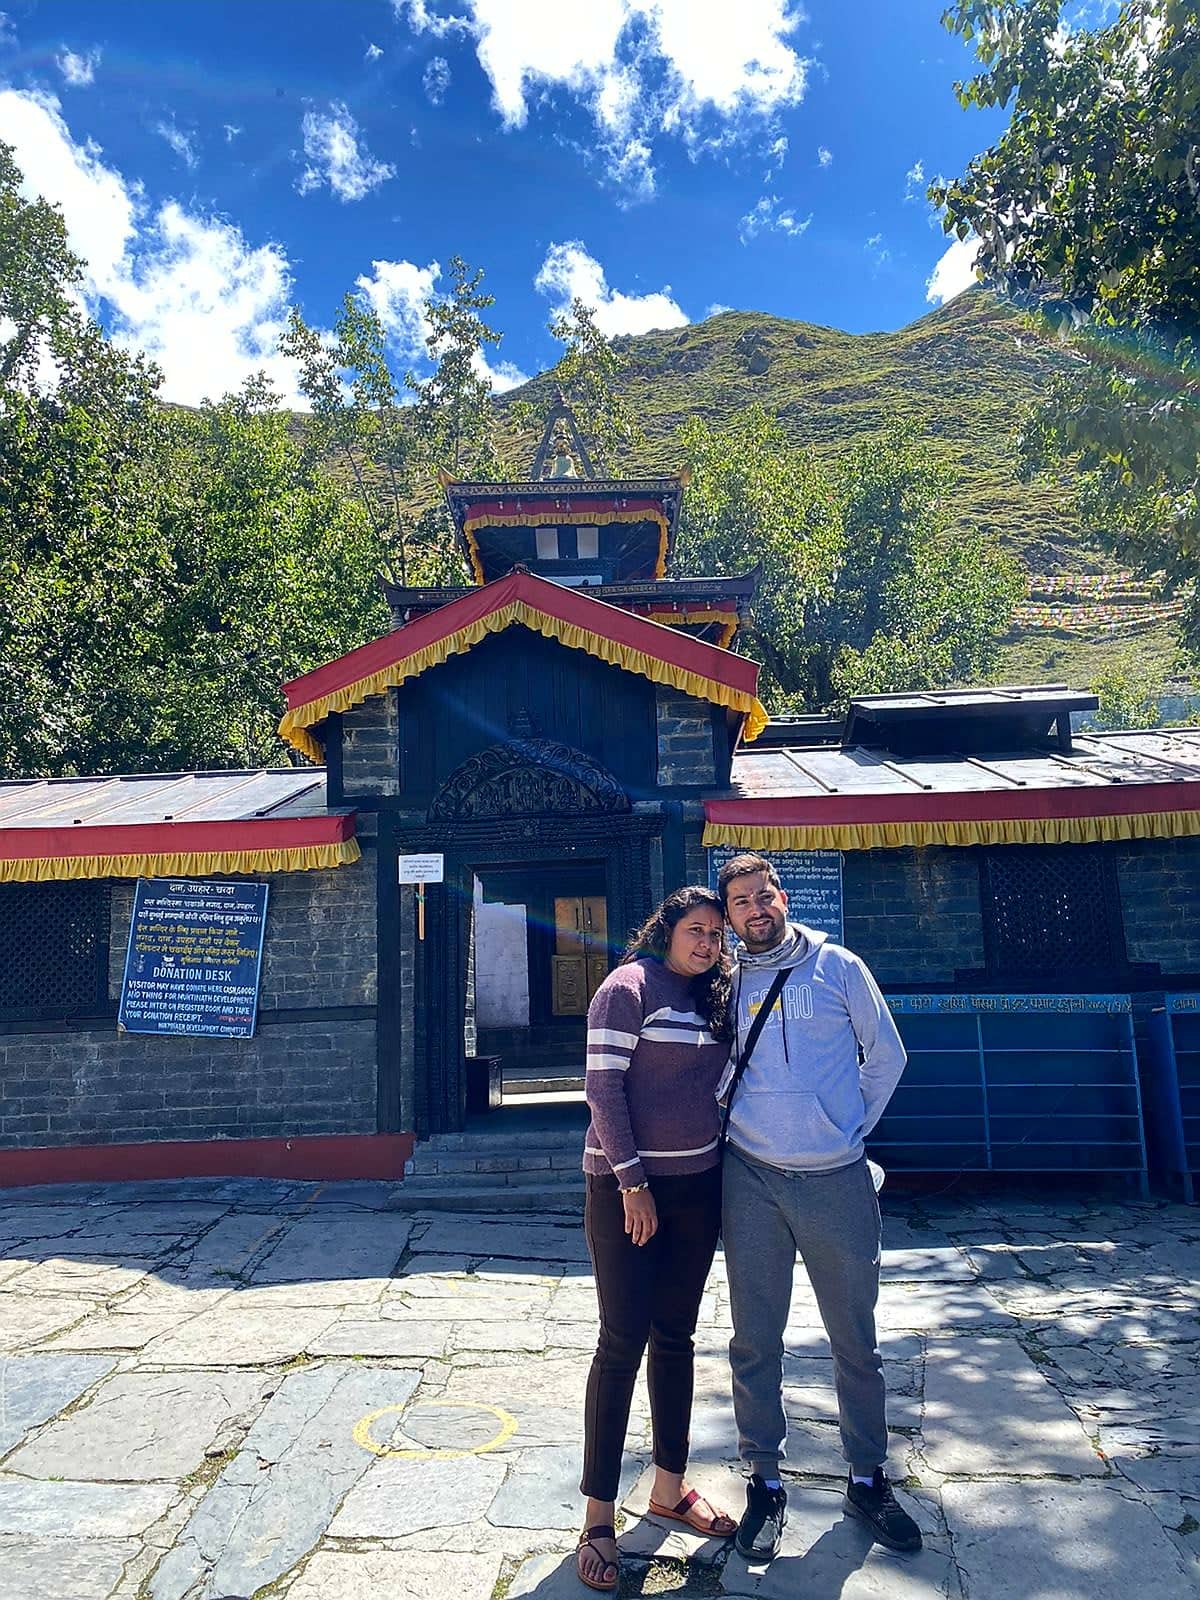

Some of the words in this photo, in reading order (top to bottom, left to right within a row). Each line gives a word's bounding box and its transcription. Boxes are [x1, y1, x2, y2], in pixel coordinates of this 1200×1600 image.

[153, 967, 202, 980] DONATION
[205, 969, 232, 982] DESK
[156, 982, 169, 991] MAY
[170, 983, 185, 991] HAVE
[186, 984, 207, 992] DONATE
[207, 985, 222, 993] HERE
[127, 990, 141, 999] AND
[141, 991, 162, 1000] THING
[164, 992, 177, 1000] FOR
[126, 1000, 148, 1009] PLEASE
[168, 1002, 176, 1010] ON
[176, 1002, 205, 1012] REGISTER
[205, 1004, 220, 1013] BOOK
[221, 1005, 233, 1014] AND
[234, 1006, 250, 1015] TAKE
[125, 1010, 142, 1019] YOUR
[143, 1011, 173, 1020] DONATION
